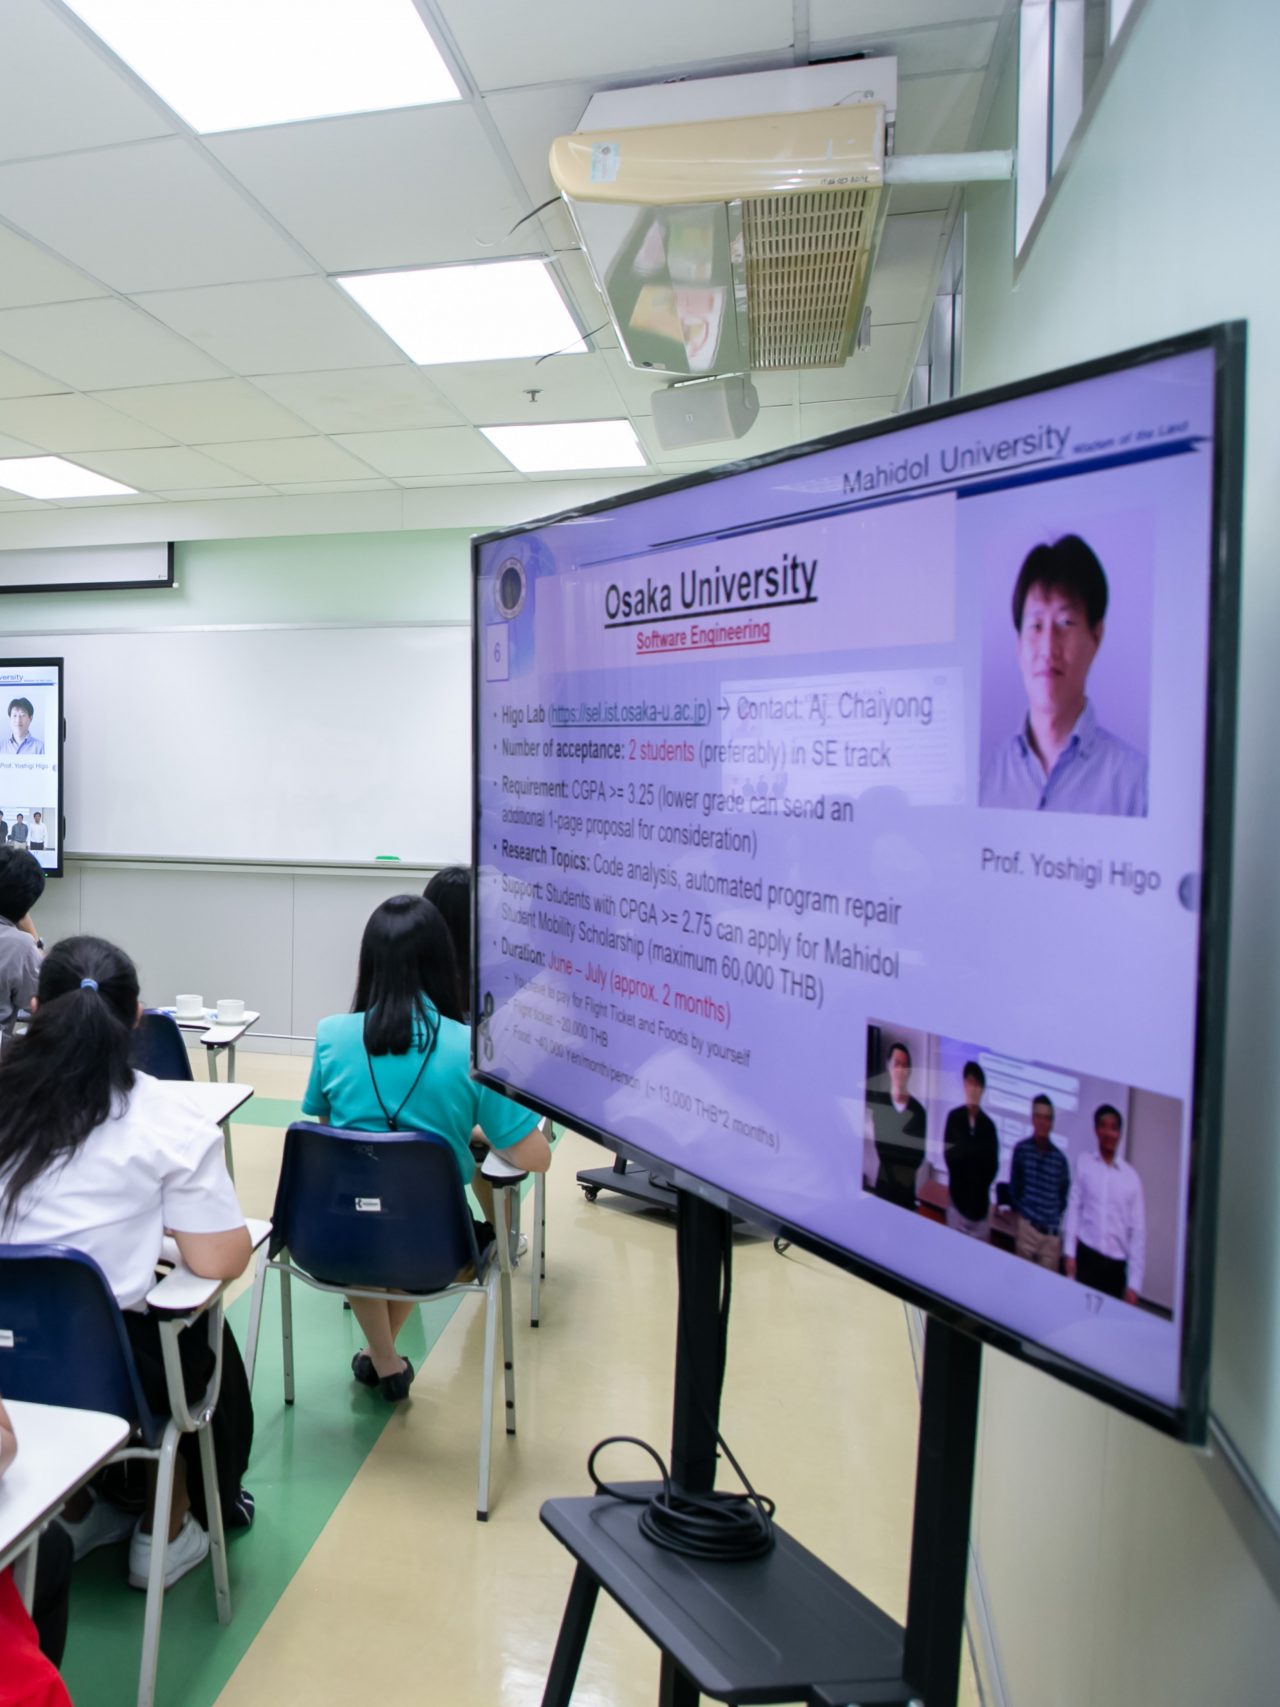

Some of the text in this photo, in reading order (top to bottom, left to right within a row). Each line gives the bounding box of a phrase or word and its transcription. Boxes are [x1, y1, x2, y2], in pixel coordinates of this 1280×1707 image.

[842, 425, 1070, 495] Mahidol University
[1073, 420, 1189, 454] Wisdom of the Land
[605, 553, 818, 620] Osaka University
[493, 641, 502, 663] 6
[636, 618, 770, 651] Software Engineering
[502, 705, 524, 728] Higo
[527, 703, 546, 723] Lab
[737, 695, 803, 720] Contact:
[839, 690, 934, 725] Chaiyong
[502, 738, 892, 771] Number of acceptance: 2 students (preferably) in SE track
[502, 775, 854, 822] Requirement: CGPA >= 3.25 (lower grade can send an
[502, 806, 758, 860] additional 1-page proposal for consideration)
[502, 839, 902, 927] Research Topics: Code analysis, automated program repair
[981, 847, 1162, 895] Prof. Yoshigi Higo
[502, 872, 900, 979] Support: Students with CPGA >= 2.75 can apply for Mahidol
[501, 902, 824, 1010] Student Mobility Scholarship (maximum 60,000 THB)
[501, 936, 546, 967] Duration:
[548, 951, 574, 976] June
[584, 961, 608, 992] July
[610, 967, 659, 1003] (approx.
[662, 983, 671, 1006] 2
[675, 991, 732, 1031] months)
[585, 995, 609, 1019] Flight
[610, 1003, 636, 1029] Ticket
[638, 1017, 656, 1036] and
[658, 1020, 689, 1046] Foods
[691, 1032, 705, 1056] by
[707, 1041, 751, 1068] yourself
[1085, 1292, 1105, 1315] 17
